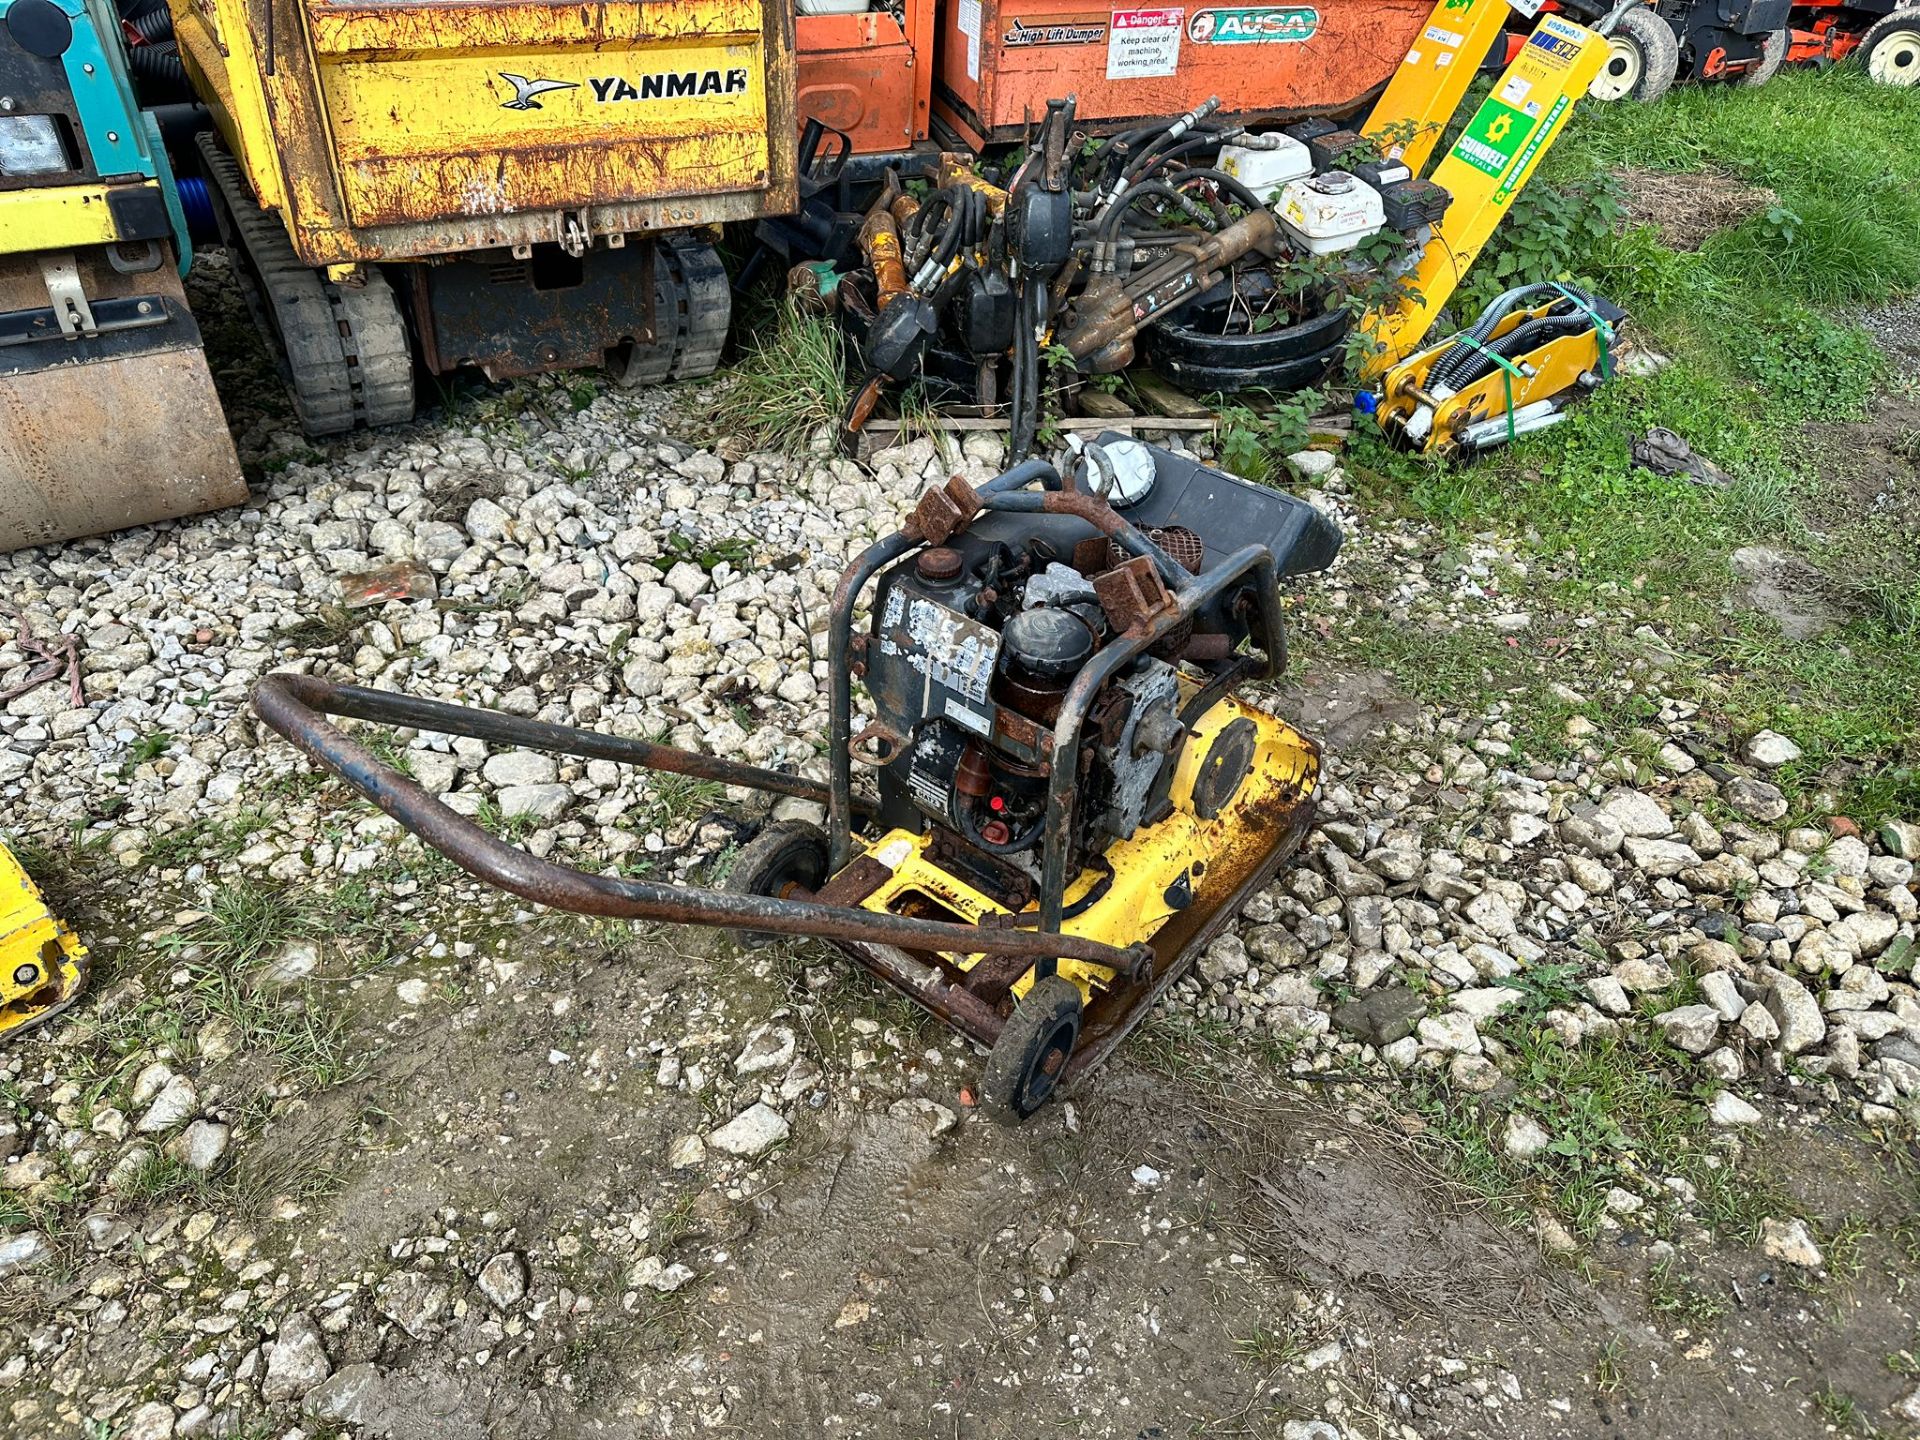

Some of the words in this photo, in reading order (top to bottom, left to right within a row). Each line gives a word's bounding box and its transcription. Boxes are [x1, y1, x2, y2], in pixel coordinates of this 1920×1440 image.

[1218, 14, 1307, 35] AUSA
[1020, 29, 1044, 44] High
[1046, 28, 1064, 40] Lift
[1066, 28, 1104, 43] Dumper
[1120, 36, 1140, 45] Keep
[1141, 36, 1160, 44] clear
[1161, 35, 1170, 43] of
[1550, 40, 1581, 60] SPE
[1117, 58, 1147, 67] working
[589, 69, 747, 102] YANMAR
[1458, 134, 1509, 170] SUNBELT
[1503, 144, 1536, 190] SUNBELT
[1534, 95, 1569, 144] RENTALS
[1460, 150, 1494, 172] RENTALS
